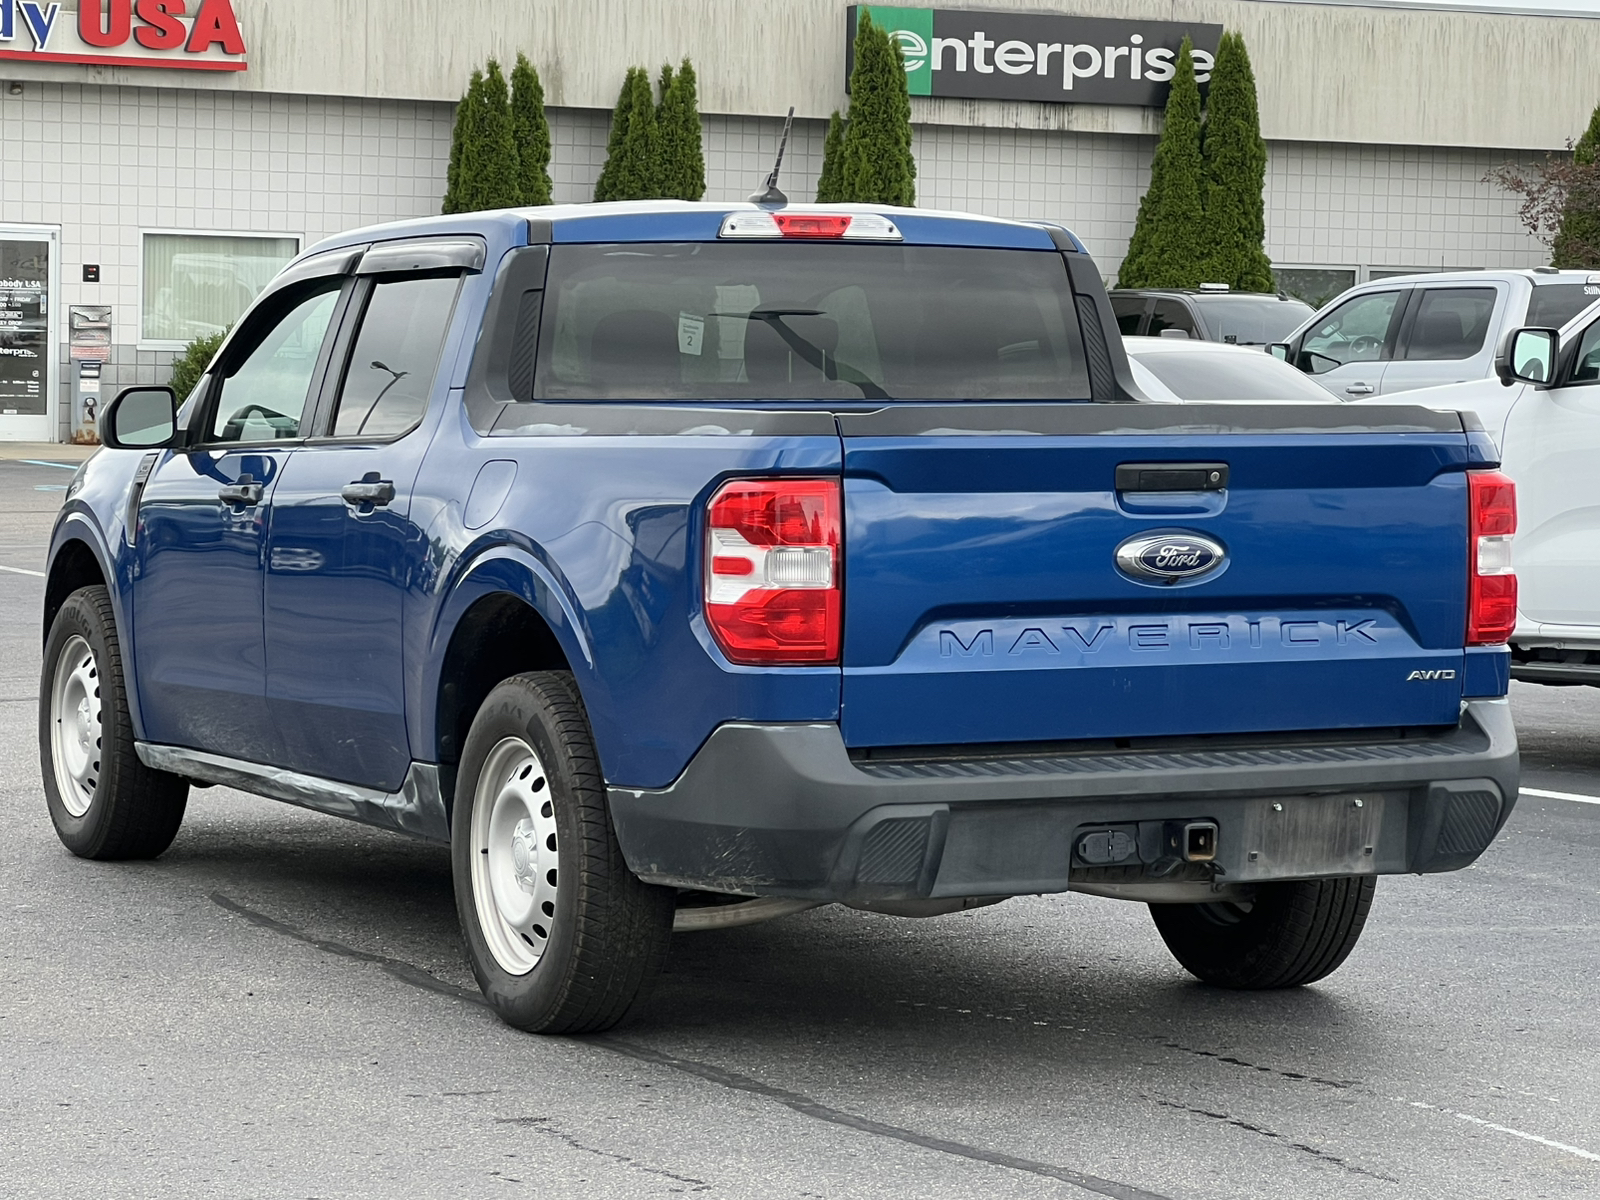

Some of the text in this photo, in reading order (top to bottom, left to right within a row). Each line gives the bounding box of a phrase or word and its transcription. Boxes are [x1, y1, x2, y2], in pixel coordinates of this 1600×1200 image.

[78, 0, 247, 54] USA
[888, 29, 1215, 91] enterprise
[687, 335, 693, 346] 2
[1156, 545, 1201, 567] Ford
[939, 618, 1378, 658] MAVERICK
[1406, 669, 1456, 681] AWD
